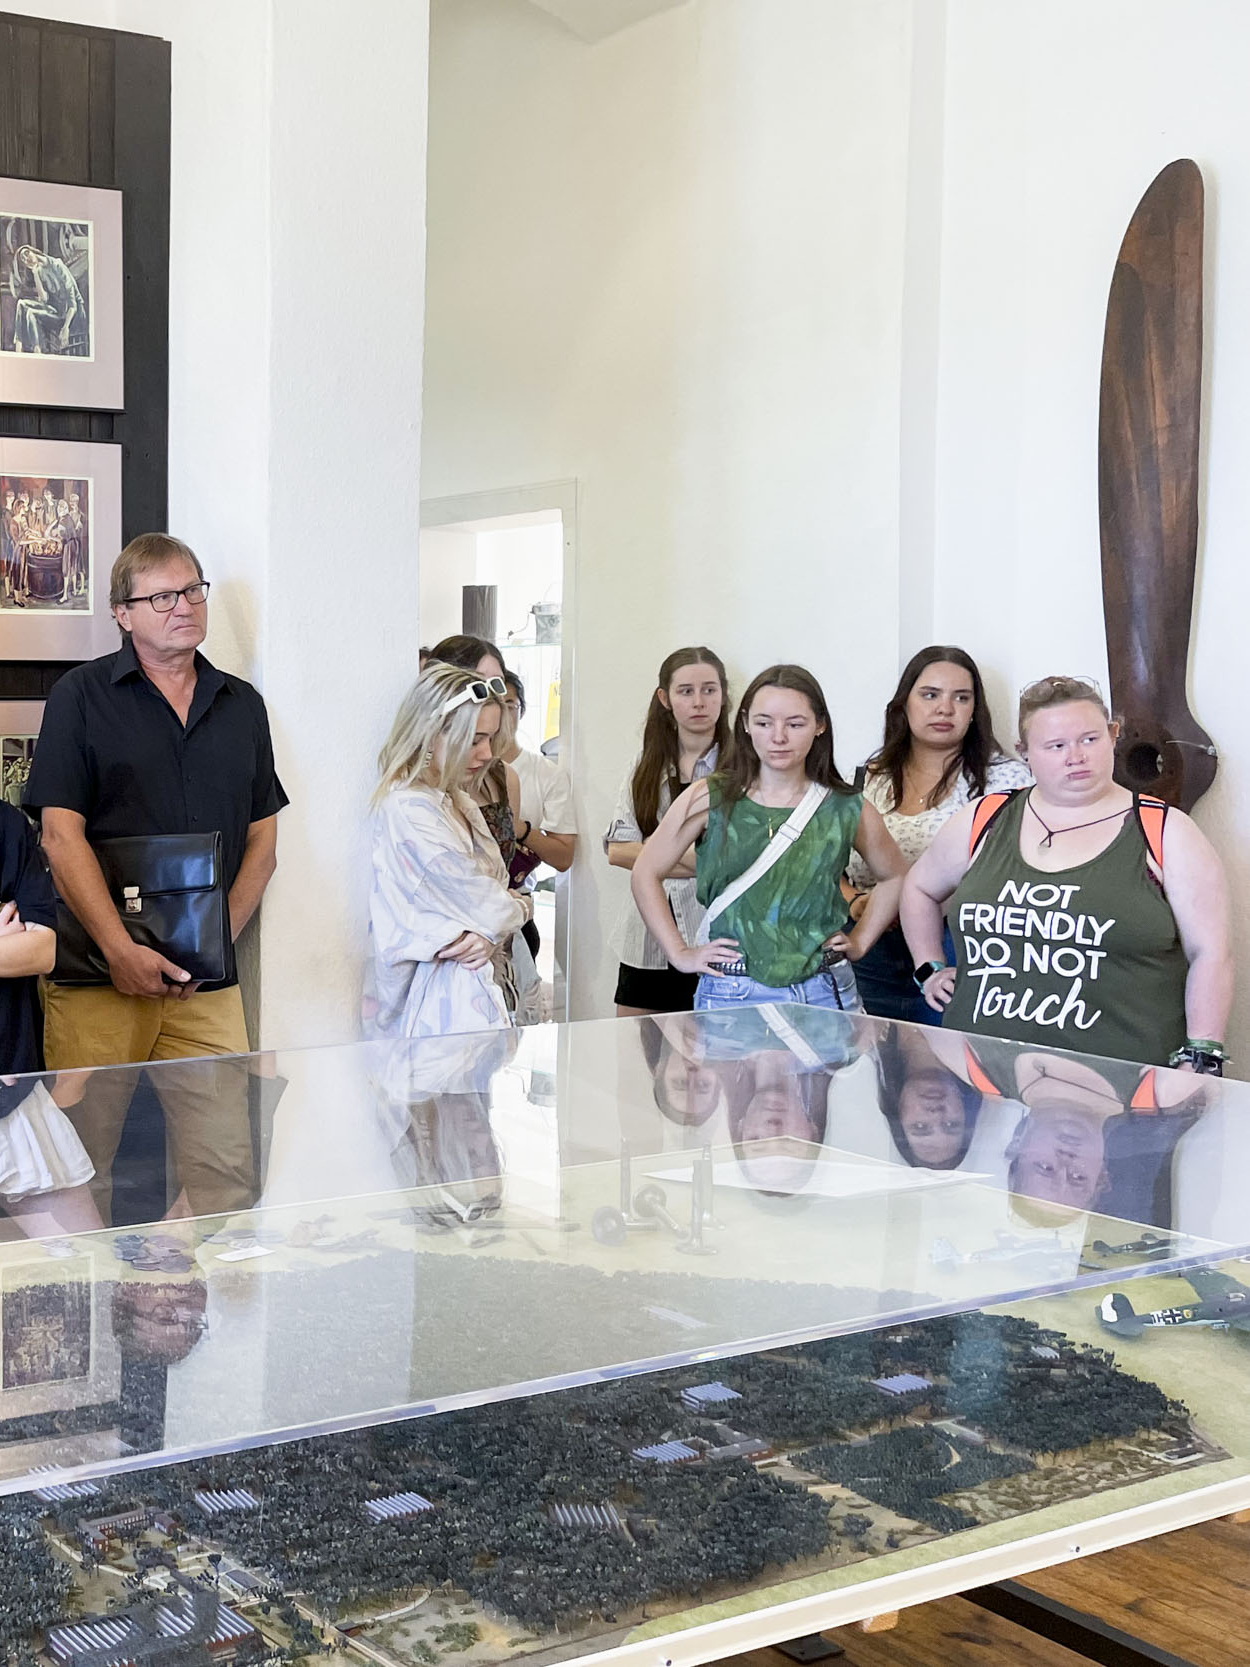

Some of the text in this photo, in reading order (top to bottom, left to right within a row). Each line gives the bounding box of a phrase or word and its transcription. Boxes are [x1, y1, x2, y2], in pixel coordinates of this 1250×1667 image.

[998, 880, 1081, 909] NOT
[959, 903, 1116, 946] FRIENDLY
[964, 935, 1107, 980] DO NOT
[967, 966, 1102, 1030] Touch
